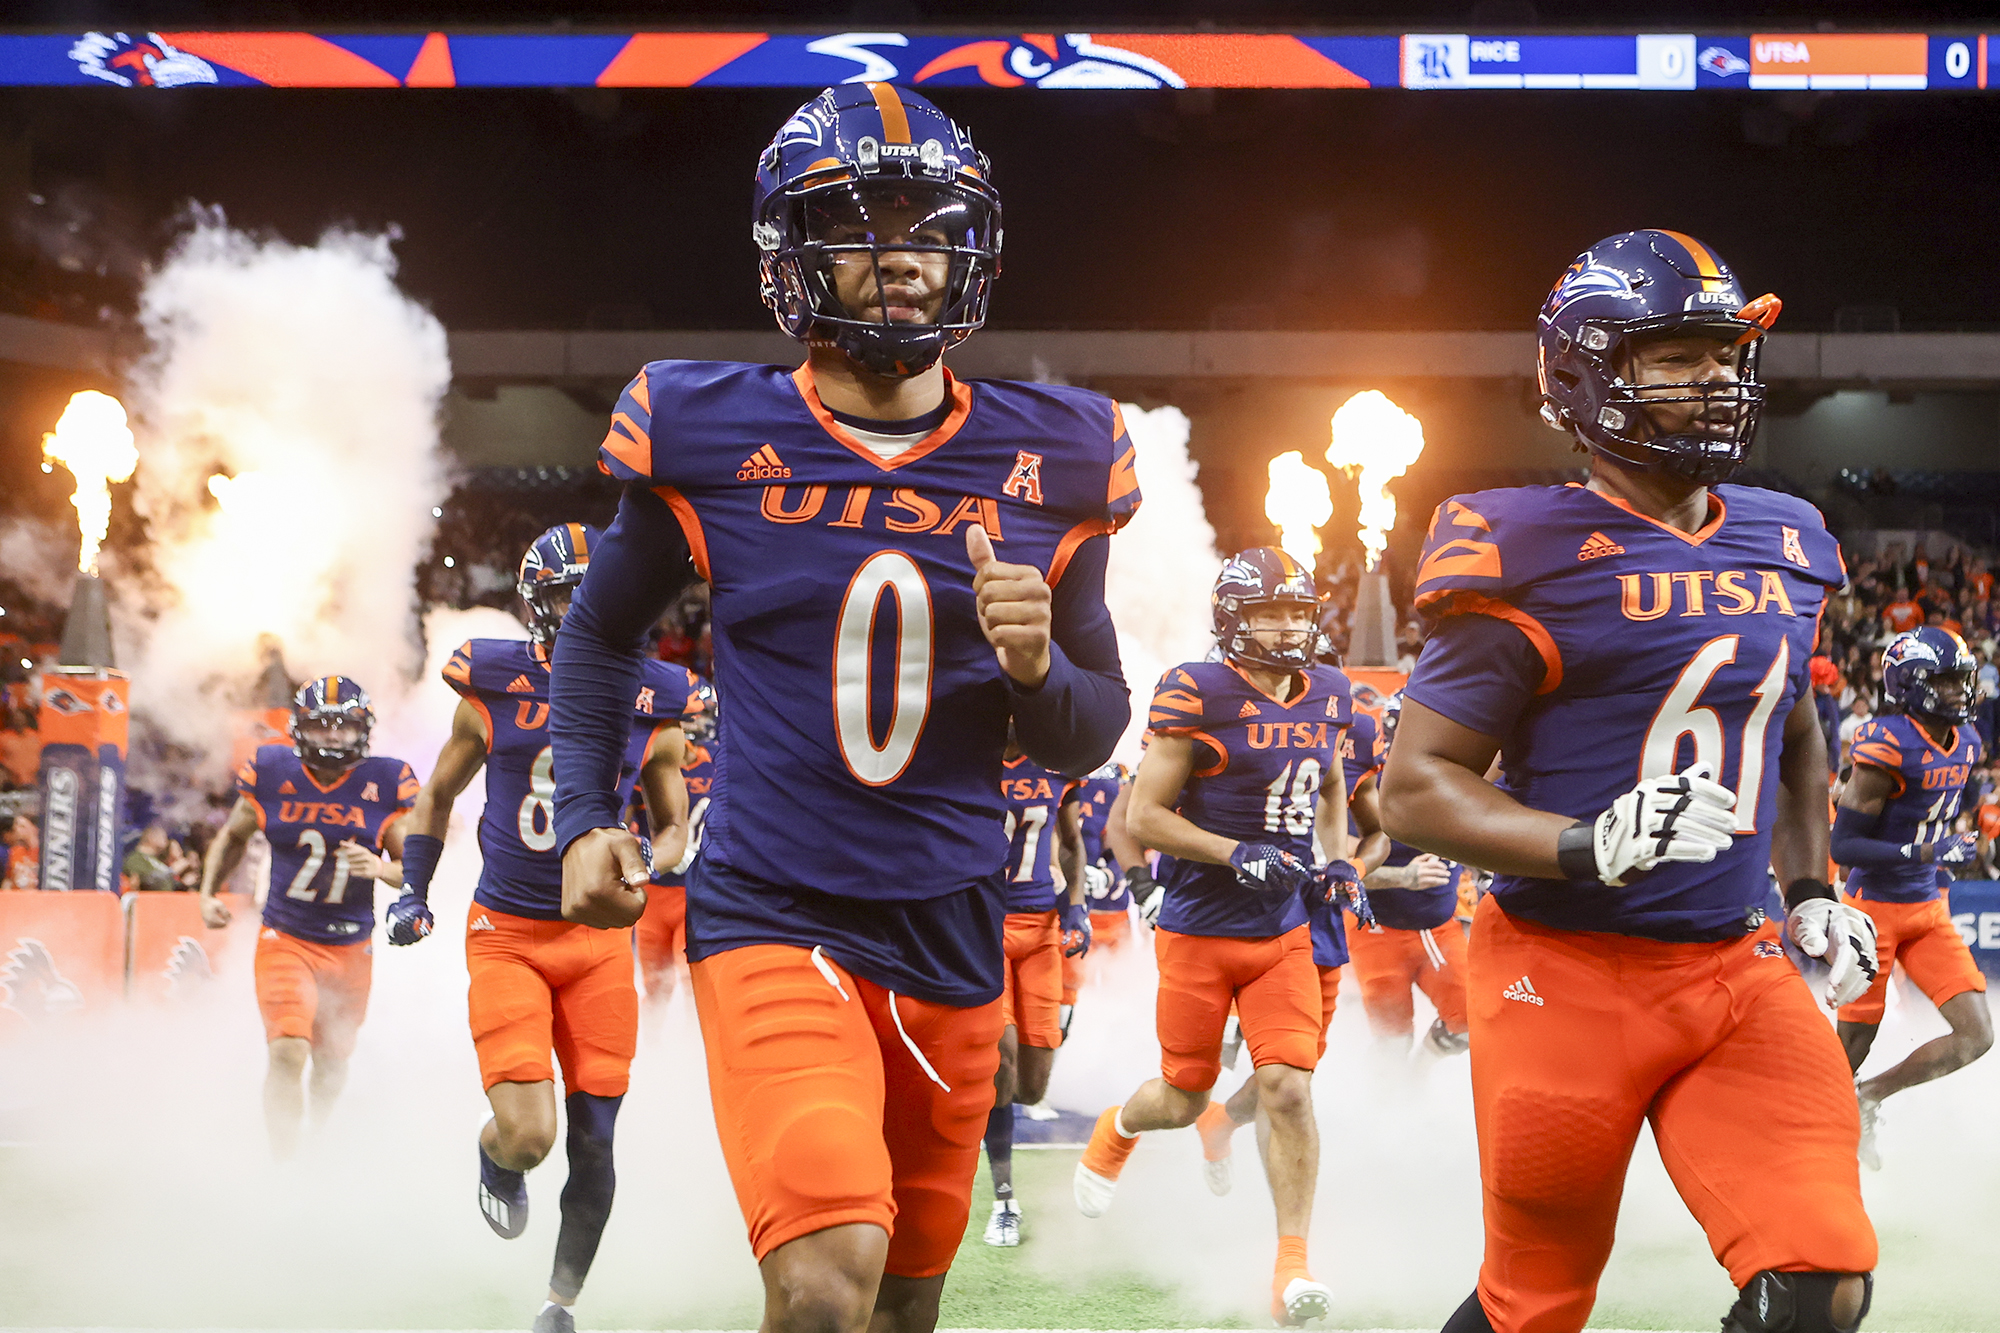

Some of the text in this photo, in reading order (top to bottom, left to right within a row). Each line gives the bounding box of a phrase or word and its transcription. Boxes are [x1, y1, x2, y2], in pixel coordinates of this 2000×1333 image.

[1470, 41, 1685, 80] RICE 0
[1755, 41, 1970, 79] UTSA 0
[880, 145, 920, 157] UTSA
[1698, 292, 1739, 306] UTSA
[736, 464, 792, 481] adidas
[1615, 570, 1797, 622] UTSA
[832, 549, 934, 787] 0
[1246, 722, 1329, 750] UTSA
[1637, 634, 1790, 835] 61
[1000, 778, 1055, 800] TSA
[1921, 763, 1969, 790] UTSA
[1264, 757, 1321, 836] 18
[278, 800, 367, 830] UTSA
[1913, 788, 1961, 846] 11
[286, 828, 357, 905] 21
[1502, 989, 1545, 1007] adidas
